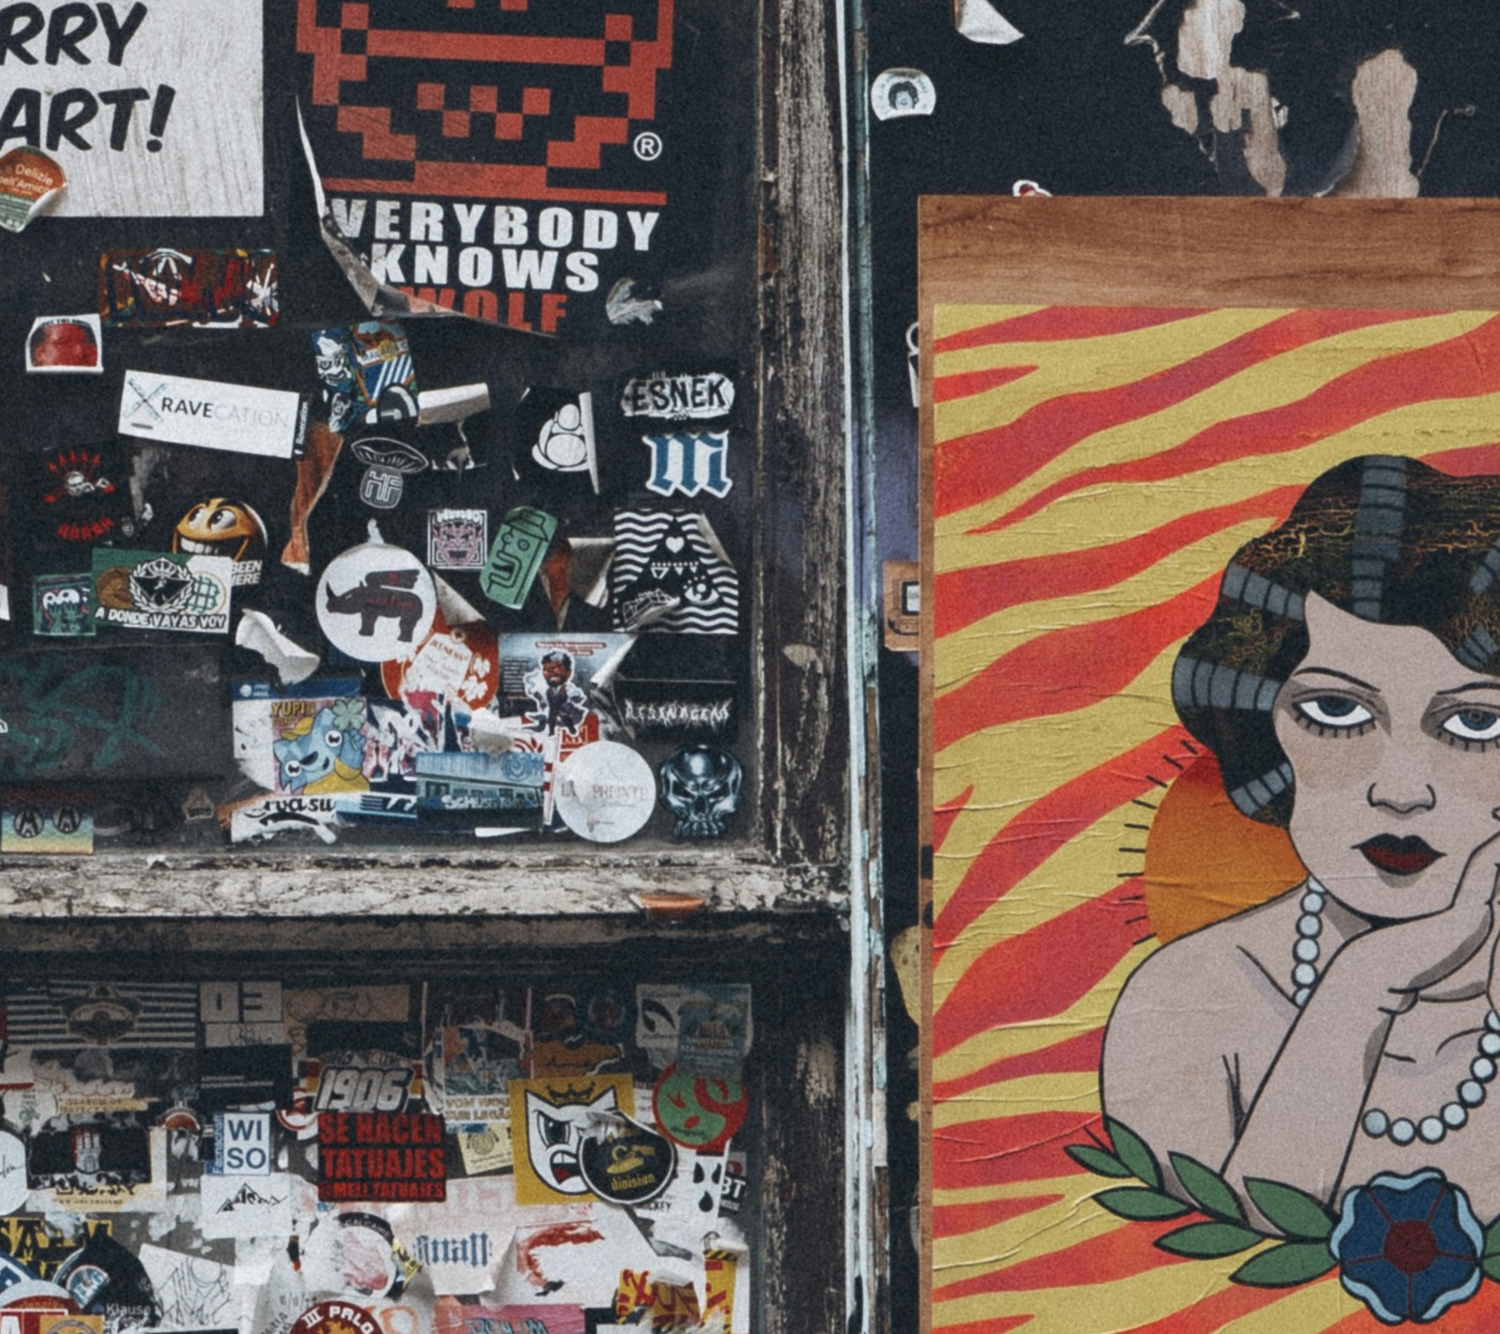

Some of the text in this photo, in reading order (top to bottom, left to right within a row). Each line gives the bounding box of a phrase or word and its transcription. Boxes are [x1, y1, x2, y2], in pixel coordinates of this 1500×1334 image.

[370, 245, 600, 292] KNOWS
[629, 378, 727, 412] ESNEK
[95, 607, 226, 629] A DONDE VAYAS VOY
[321, 1148, 446, 1179] TATUAJES
